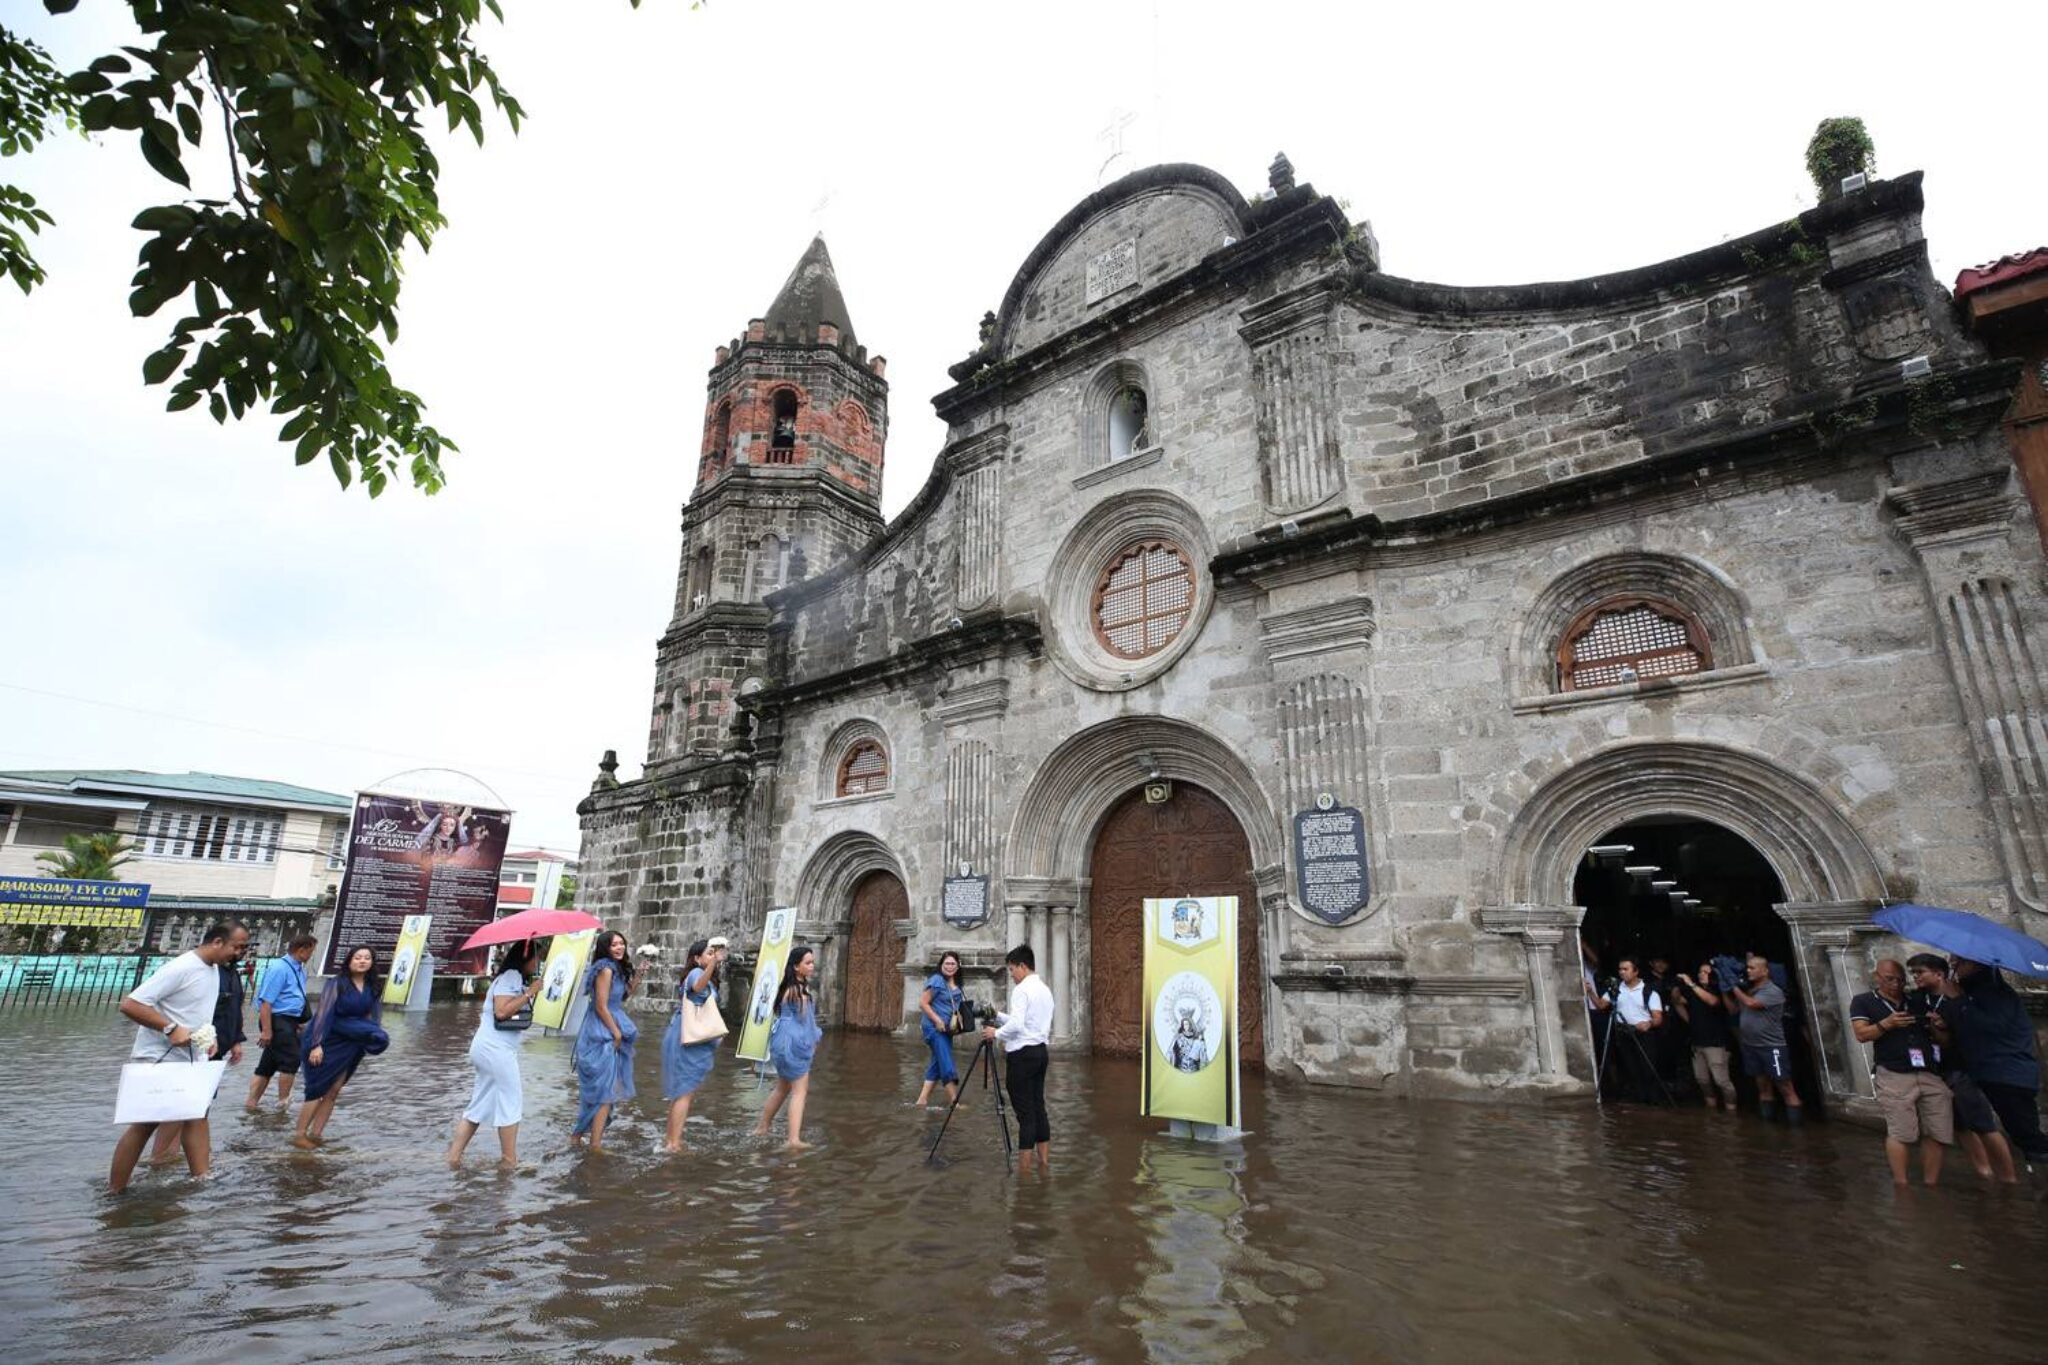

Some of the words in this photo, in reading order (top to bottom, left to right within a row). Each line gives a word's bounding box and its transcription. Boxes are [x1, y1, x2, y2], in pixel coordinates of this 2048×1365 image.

[354, 835, 376, 845] DEL
[377, 837, 423, 849] CARMEN
[0, 881, 73, 893] BARASOAIN
[77, 885, 99, 895] EYE
[102, 886, 142, 897] CLINIC
